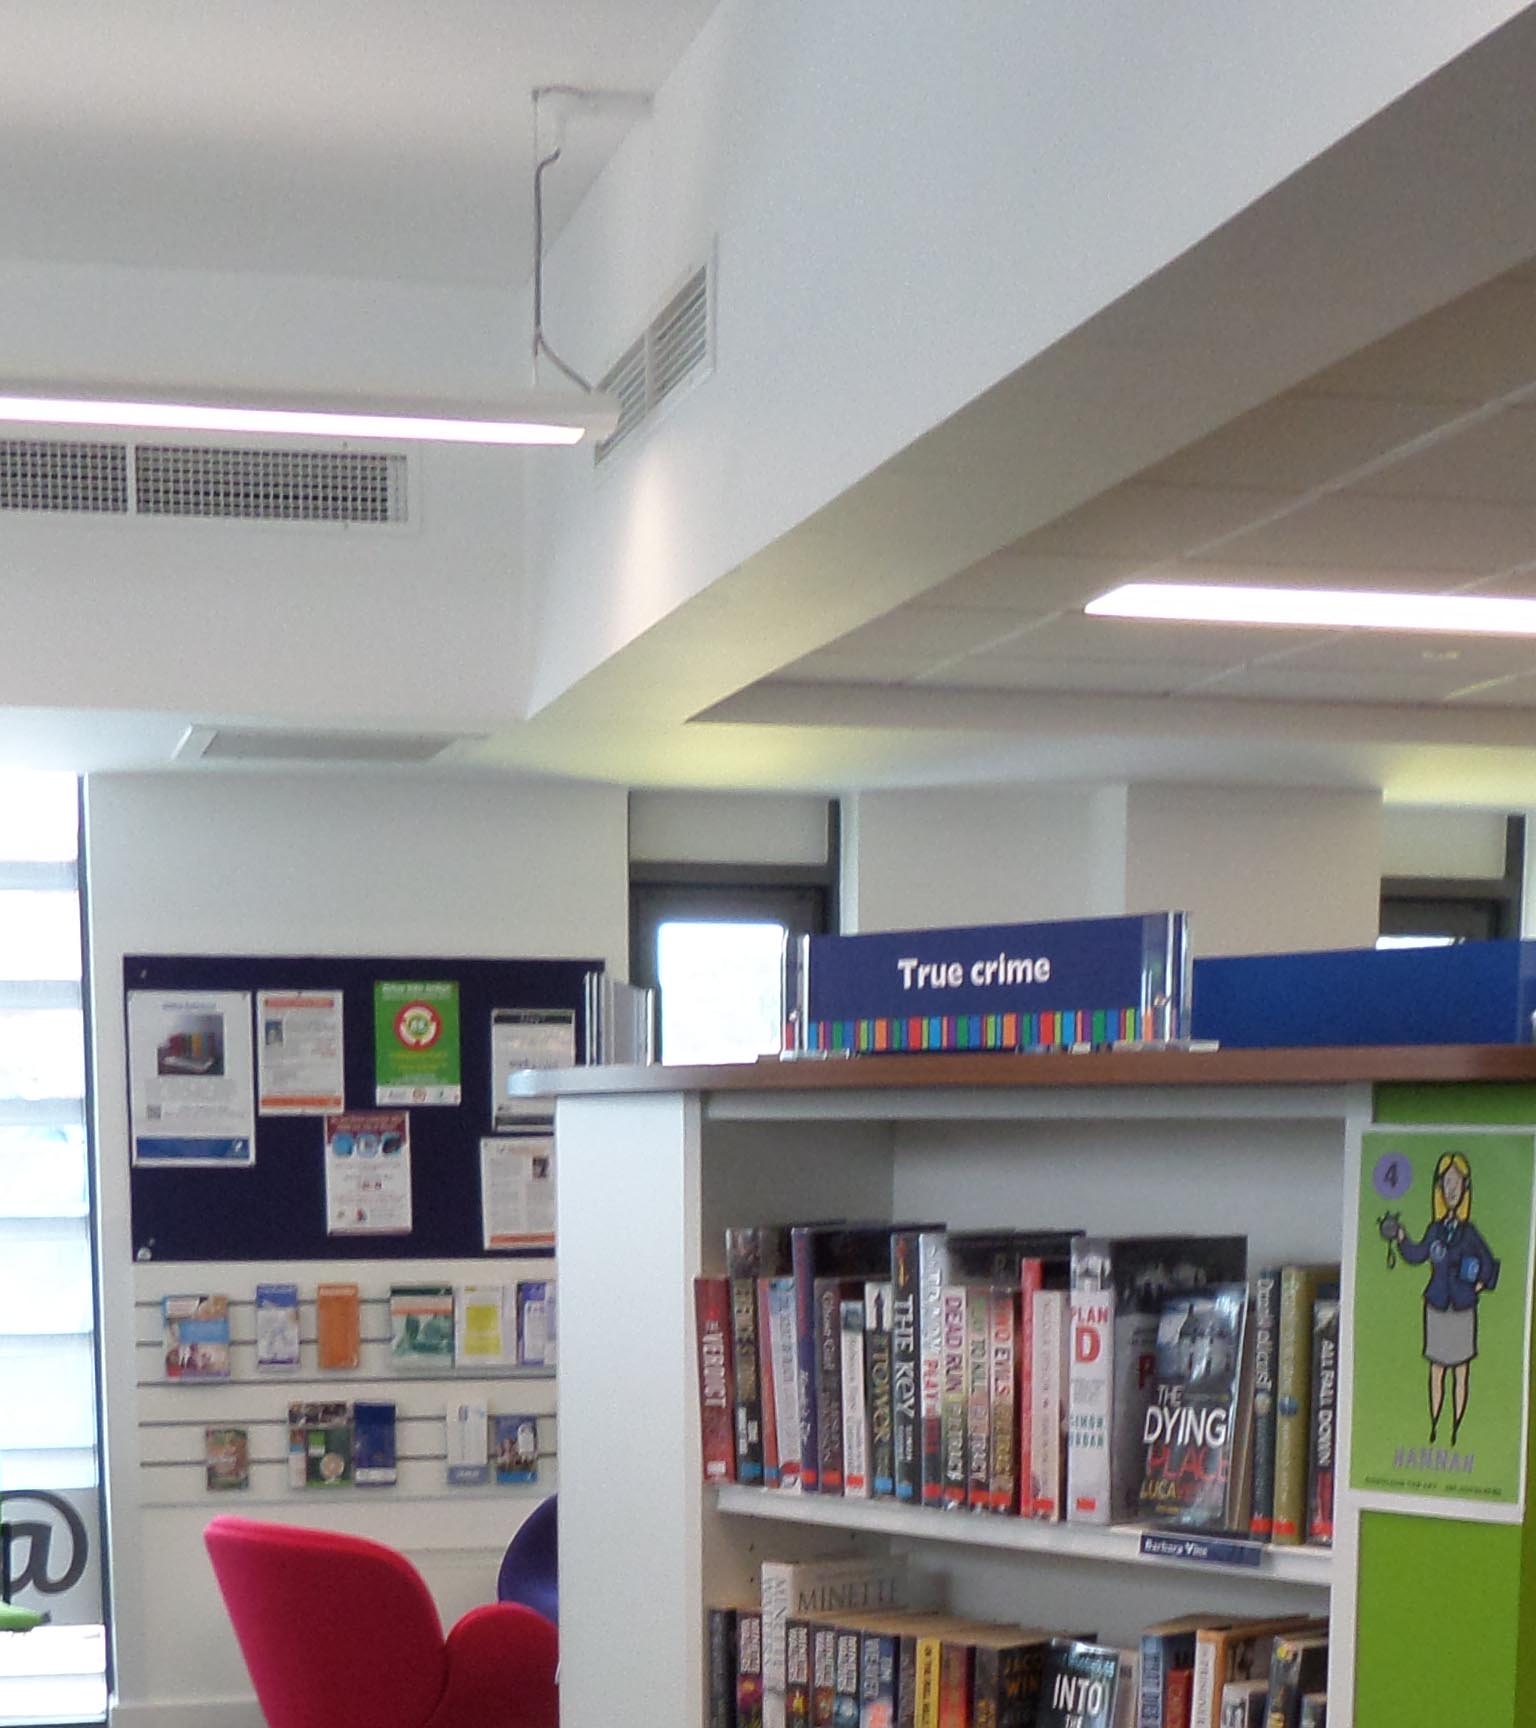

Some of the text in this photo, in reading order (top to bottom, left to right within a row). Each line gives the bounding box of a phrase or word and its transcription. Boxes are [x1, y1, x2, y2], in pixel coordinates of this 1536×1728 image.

[898, 952, 1051, 990] True crime
[1383, 1162, 1399, 1189] 4
[894, 1293, 914, 1352] THE
[945, 1296, 963, 1349] DEAD
[1071, 1306, 1108, 1326] PLAN
[1075, 1326, 1101, 1364] D
[703, 1333, 727, 1408] VERDICT
[945, 1354, 963, 1392] RUN
[970, 1358, 986, 1392] KILL
[994, 1346, 1012, 1395] EVILS
[871, 1350, 893, 1443] TOWER
[1157, 1385, 1185, 1407] THE
[1317, 1339, 1334, 1467] ALL FALL DOWN
[1143, 1407, 1227, 1447] DYING
[970, 1432, 987, 1482] TRACY
[1148, 1445, 1229, 1484] PLACE
[1393, 1446, 1475, 1474] HANNAH
[1140, 1479, 1177, 1500] LUCA
[864, 1638, 880, 1699] WEAVER
[1052, 1674, 1106, 1715] INTO
